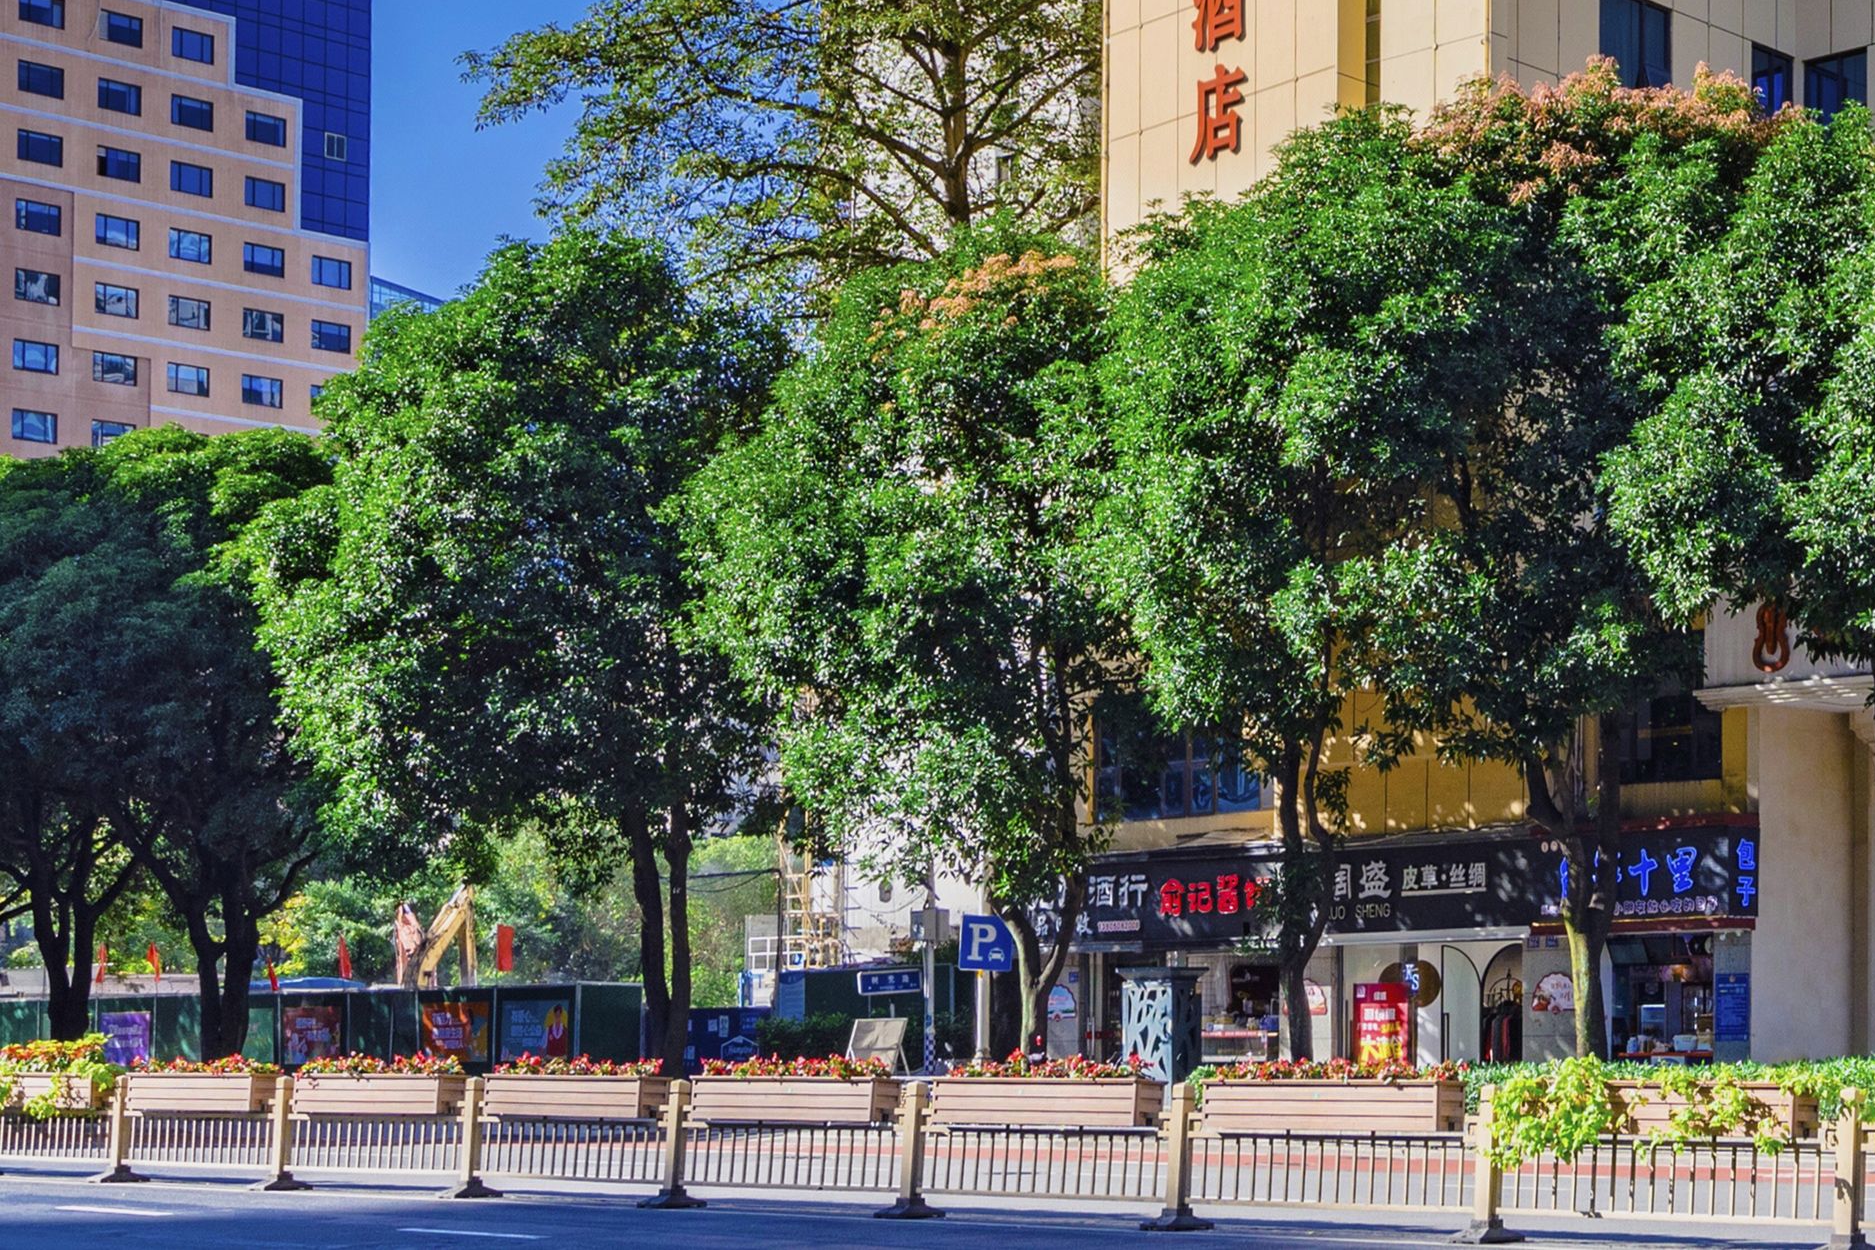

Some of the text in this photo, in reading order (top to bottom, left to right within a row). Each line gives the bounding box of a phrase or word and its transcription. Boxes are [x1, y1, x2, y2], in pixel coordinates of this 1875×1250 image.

[1736, 838, 1757, 908] 包子
[1355, 903, 1391, 919] SHENG
[968, 923, 996, 961] P
